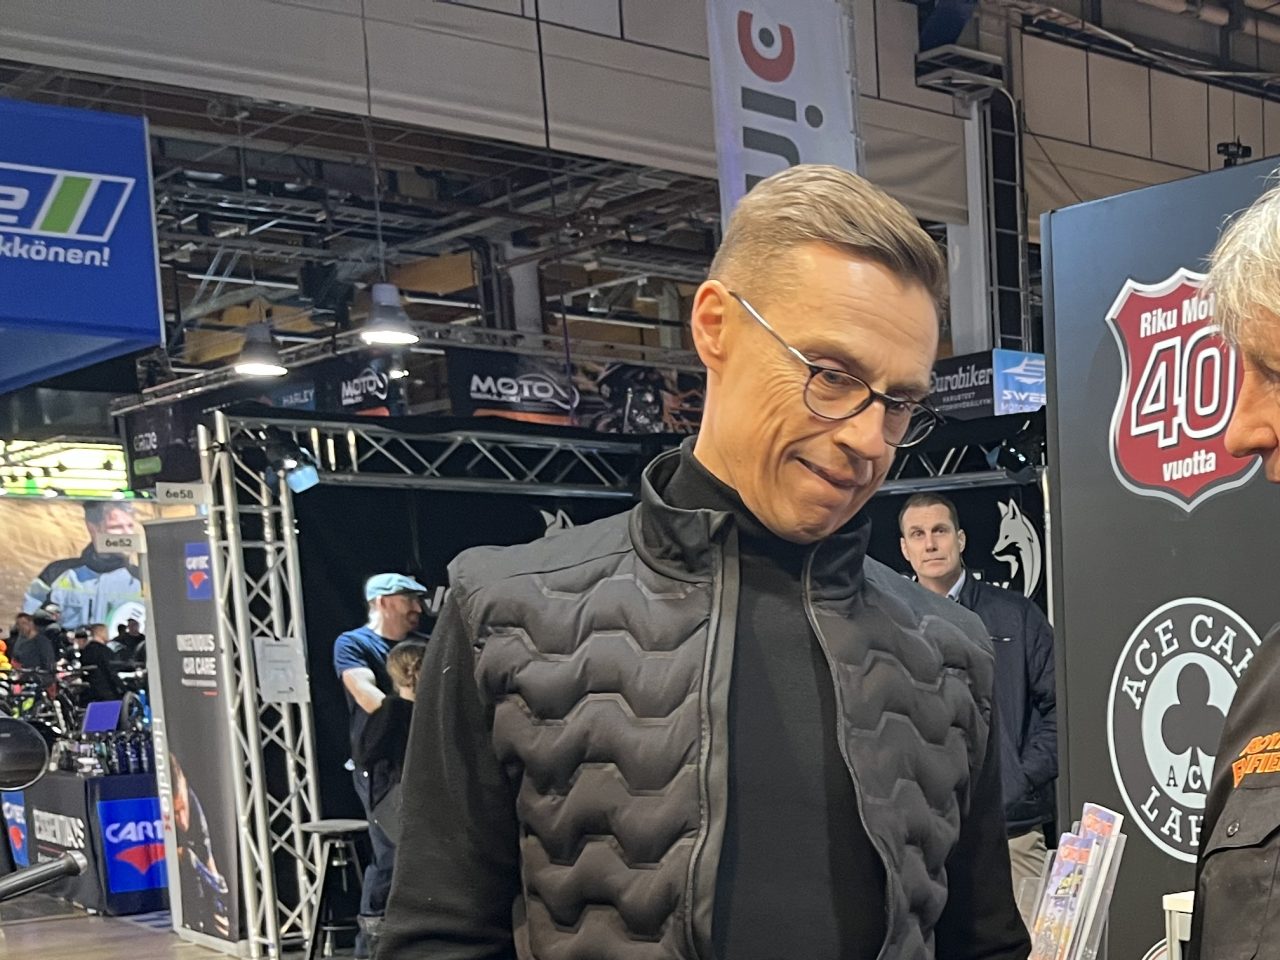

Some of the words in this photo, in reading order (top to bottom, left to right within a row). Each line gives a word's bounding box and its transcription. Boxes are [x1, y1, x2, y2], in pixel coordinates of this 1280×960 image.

[1140, 307, 1178, 338] Riku
[470, 374, 554, 398] MOTO
[1131, 325, 1236, 448] 40
[1162, 449, 1217, 482] vuotta
[165, 489, 194, 500] 6e58
[105, 538, 132, 548] 6e52
[1121, 618, 1180, 710] ACE
